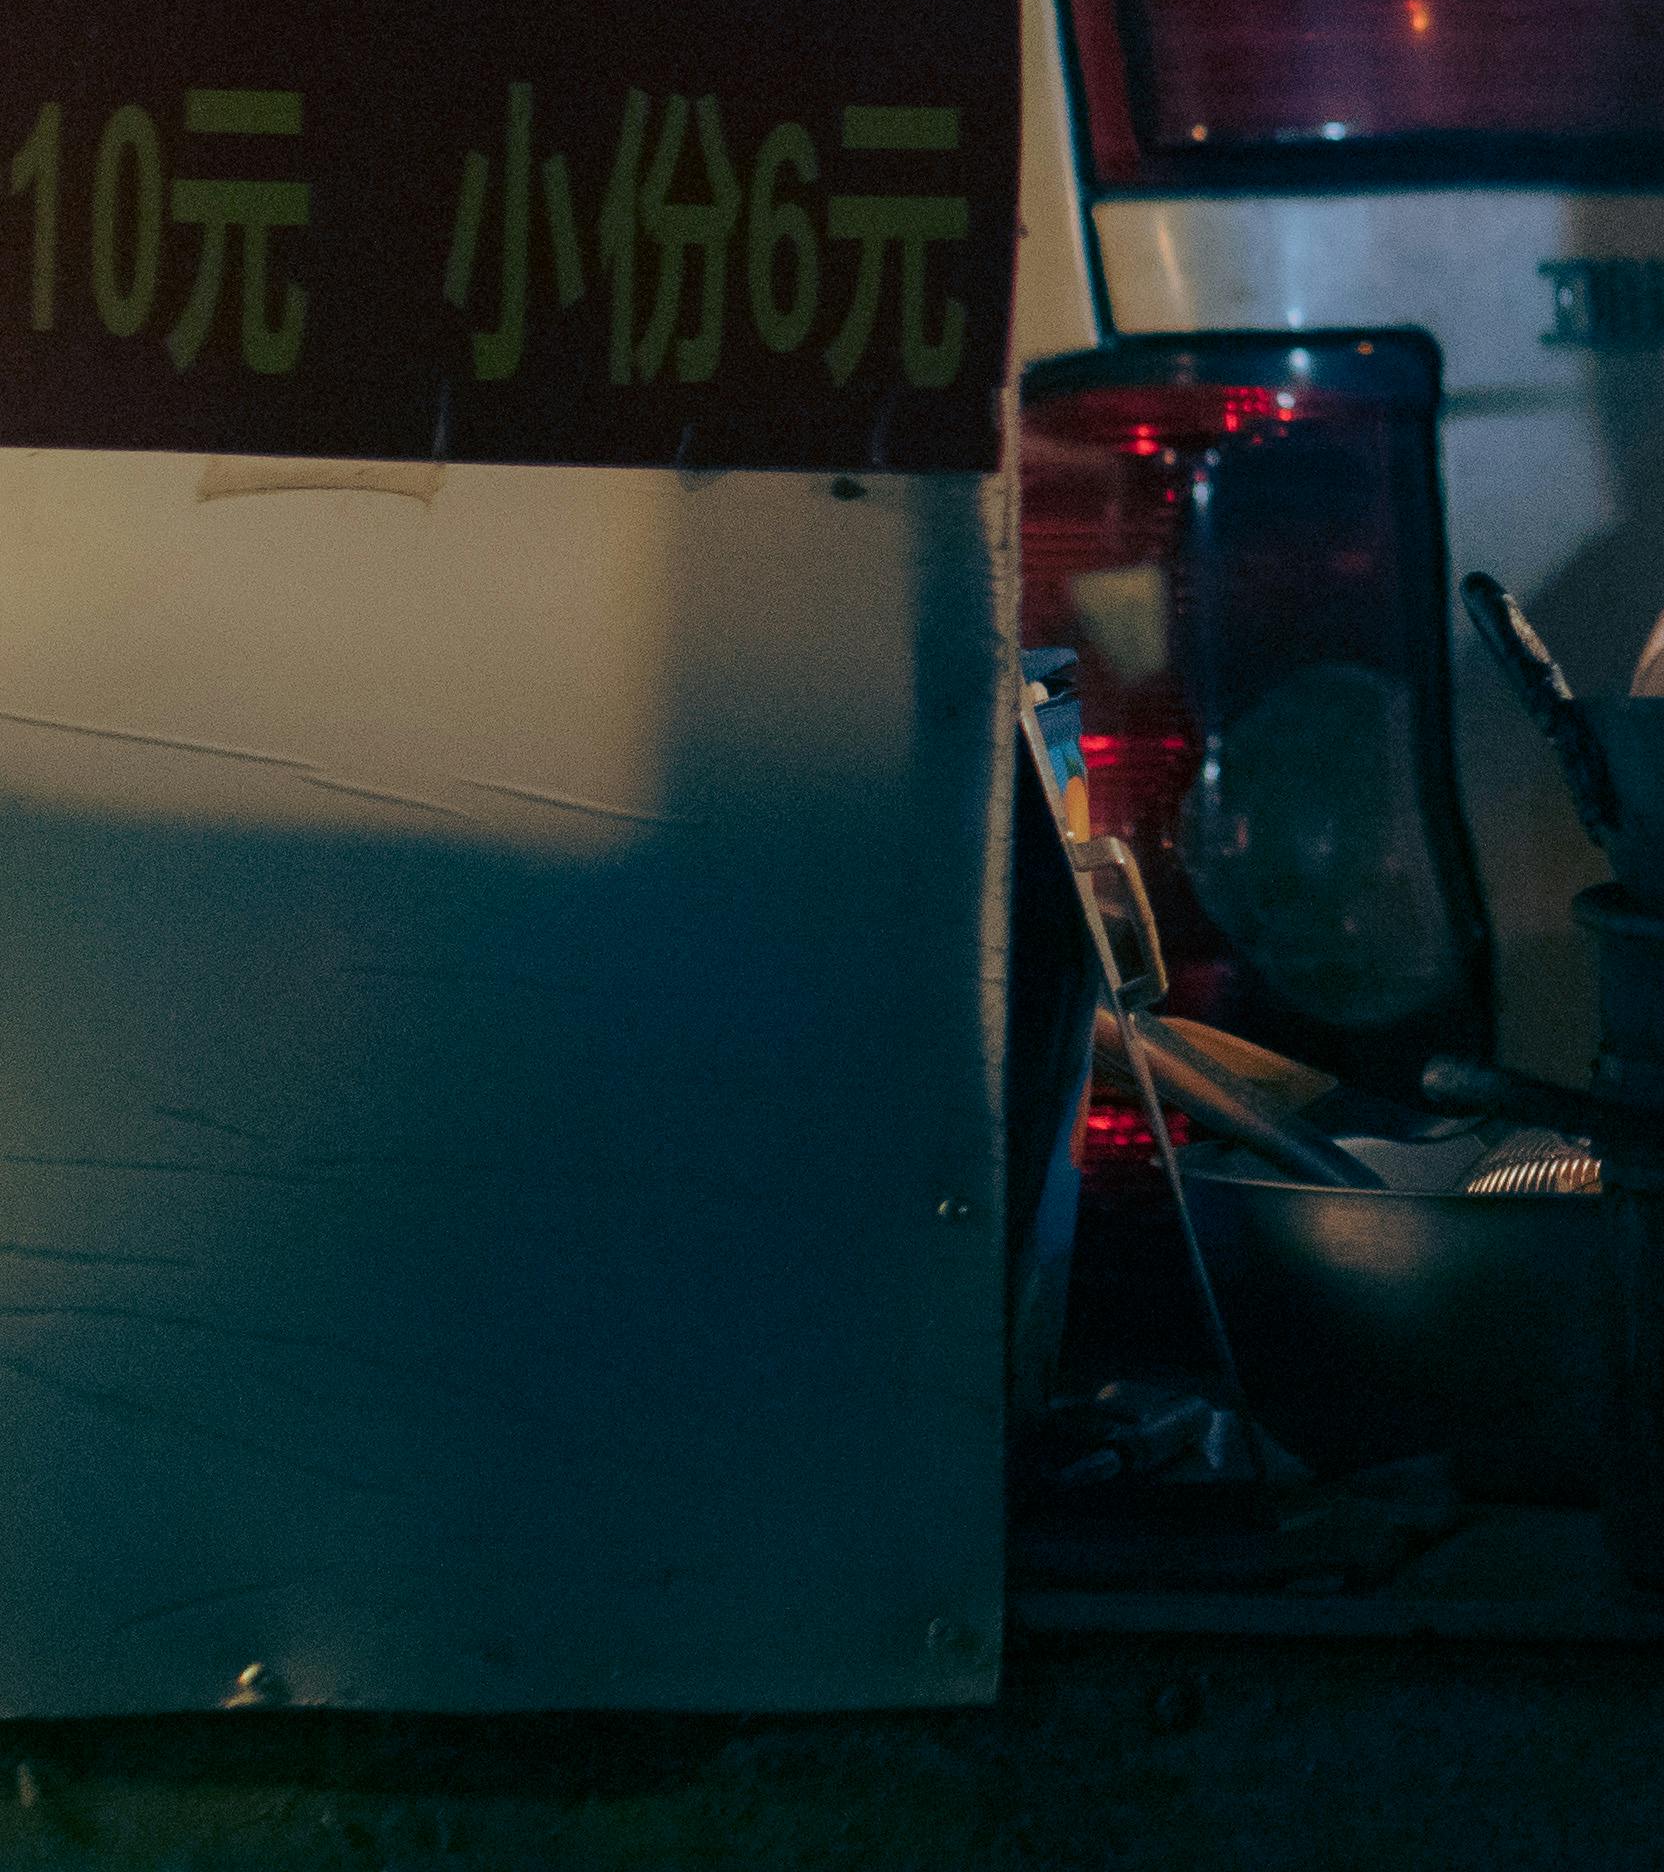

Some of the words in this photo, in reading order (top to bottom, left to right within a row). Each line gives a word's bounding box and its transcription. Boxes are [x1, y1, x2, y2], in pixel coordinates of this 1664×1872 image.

[8, 88, 313, 377] 10元
[441, 81, 971, 389] 小份6元
